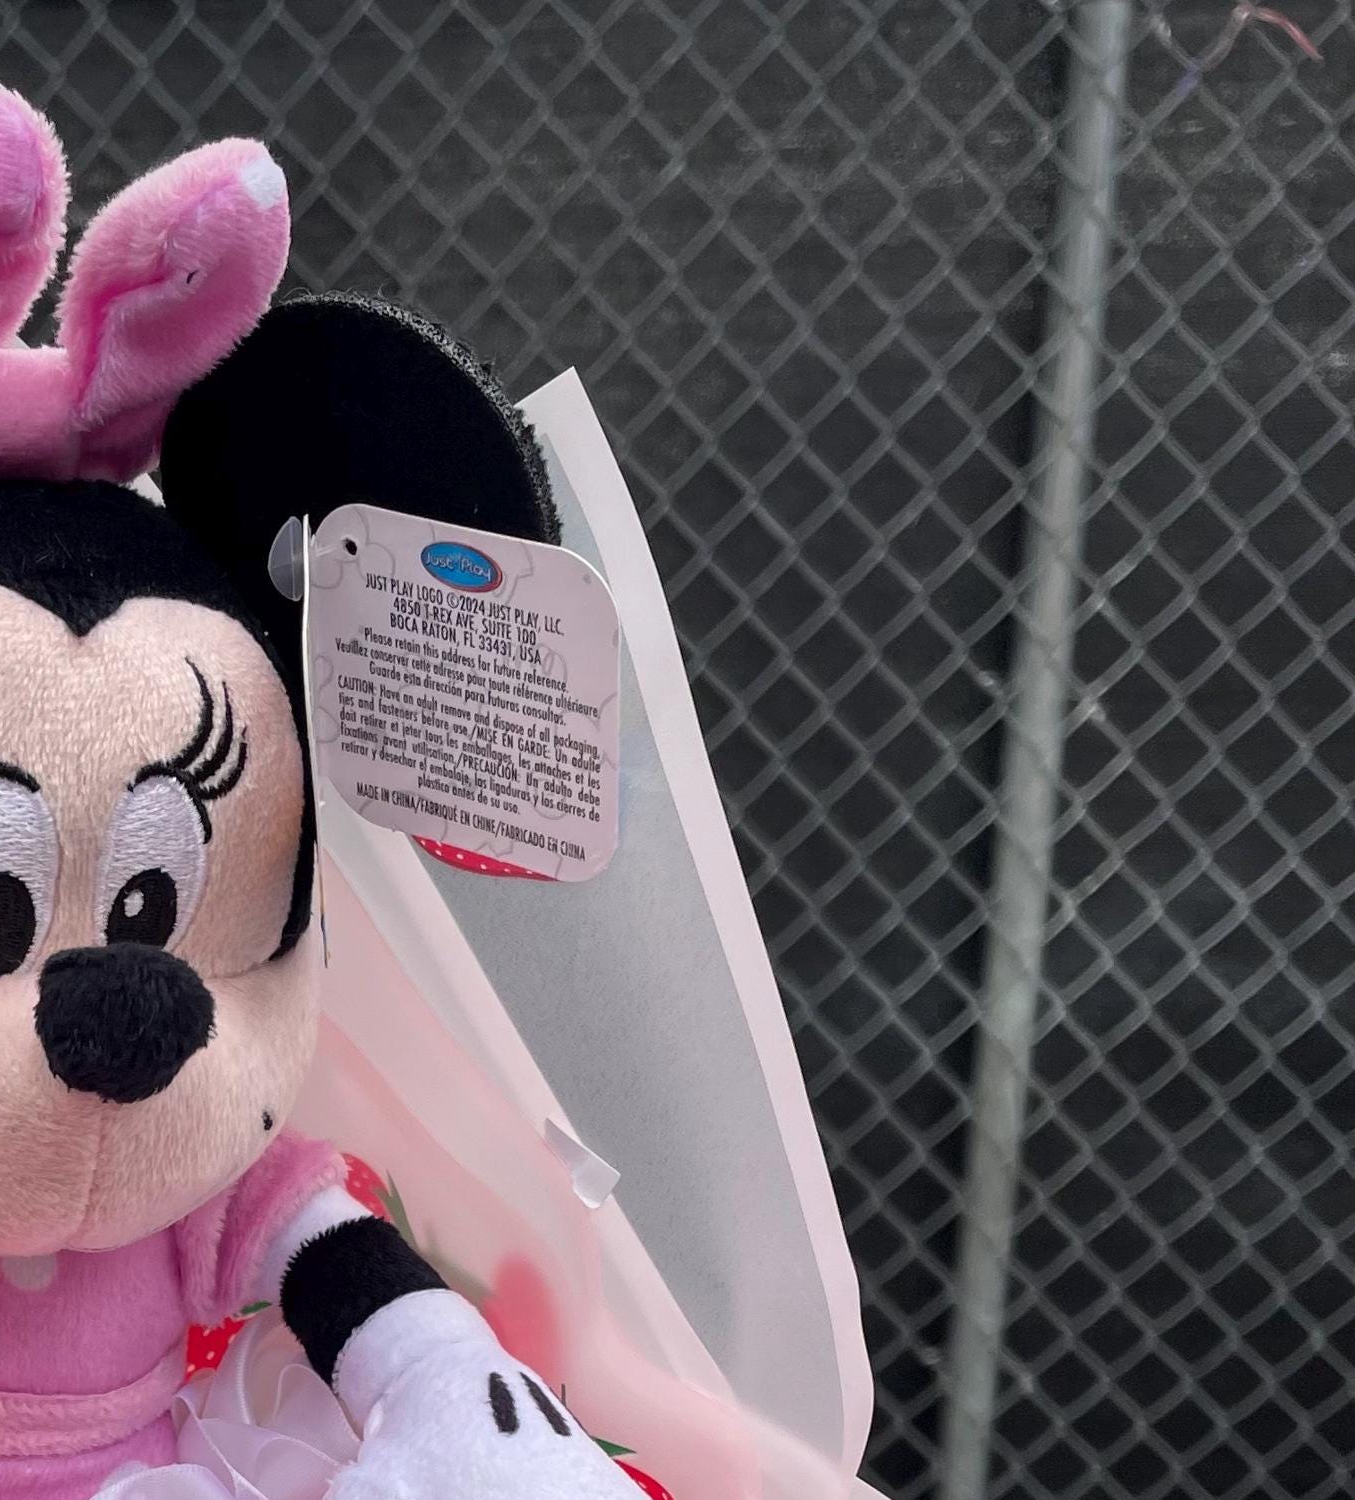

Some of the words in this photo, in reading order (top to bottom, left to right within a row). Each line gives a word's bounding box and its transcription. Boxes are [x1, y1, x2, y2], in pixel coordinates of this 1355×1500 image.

[424, 553, 454, 570] Just
[460, 558, 491, 581] Play
[365, 573, 387, 592] JUST
[391, 579, 413, 596] PLAY
[416, 585, 443, 605] LOGO
[488, 602, 511, 621] JUST
[393, 598, 420, 617] 4850
[424, 604, 452, 625] T-REX
[482, 618, 511, 637] SUITE
[517, 628, 536, 645] 100
[336, 638, 368, 657] Veuillez
[371, 648, 408, 666] conserver
[412, 656, 430, 672] cette
[434, 662, 464, 681] adresse
[467, 671, 486, 688] pour
[489, 679, 510, 693] toute
[364, 628, 392, 646] Please
[395, 638, 420, 654] retain
[423, 642, 438, 658] this
[442, 647, 475, 668] address
[478, 655, 490, 672] for
[494, 659, 520, 679] future
[390, 613, 418, 633] BOCA
[464, 632, 474, 648] FL
[520, 646, 542, 665] USA
[370, 661, 400, 681] Guarde
[404, 672, 421, 686] esta
[465, 688, 484, 705] para
[488, 691, 519, 712] futuras
[380, 684, 400, 701] Have
[403, 694, 413, 704] an
[417, 694, 437, 711] adult
[441, 703, 471, 721] remove
[474, 712, 490, 726] and
[494, 714, 524, 736] dispose
[528, 724, 536, 738] of
[540, 728, 550, 742] all
[339, 693, 354, 706] ties
[358, 697, 374, 710] and
[379, 699, 418, 722] fasteners
[422, 709, 448, 730] before
[502, 733, 513, 748] EN
[555, 749, 568, 764] Un
[572, 754, 600, 772] adulte
[340, 707, 357, 722] doit
[360, 715, 386, 729] retirer
[391, 721, 398, 732] et
[402, 722, 422, 738] jeter
[425, 730, 443, 745] tous
[447, 734, 458, 749] les
[519, 754, 531, 768] les
[534, 761, 571, 781] attaches
[575, 772, 584, 785] et
[588, 778, 600, 790] les
[341, 722, 378, 742] fixations
[383, 736, 406, 751] avant
[526, 772, 539, 787] Un
[544, 778, 572, 798] adulto
[578, 788, 600, 806] debe
[342, 741, 368, 757] retirar
[372, 749, 377, 761] y
[380, 746, 416, 768] desechar
[420, 758, 427, 772] el
[475, 771, 487, 789] las
[490, 777, 530, 802] ligaduras
[533, 794, 539, 808] y
[541, 792, 554, 809] los
[557, 799, 586, 818] cierres
[589, 806, 600, 822] de
[357, 782, 378, 801] MADE
[381, 788, 389, 802] IN
[460, 810, 470, 822] EN
[548, 837, 558, 854] EN
[560, 841, 585, 861] CHINA
[452, 784, 475, 801] antes
[478, 790, 488, 804] de
[491, 796, 501, 808] su
